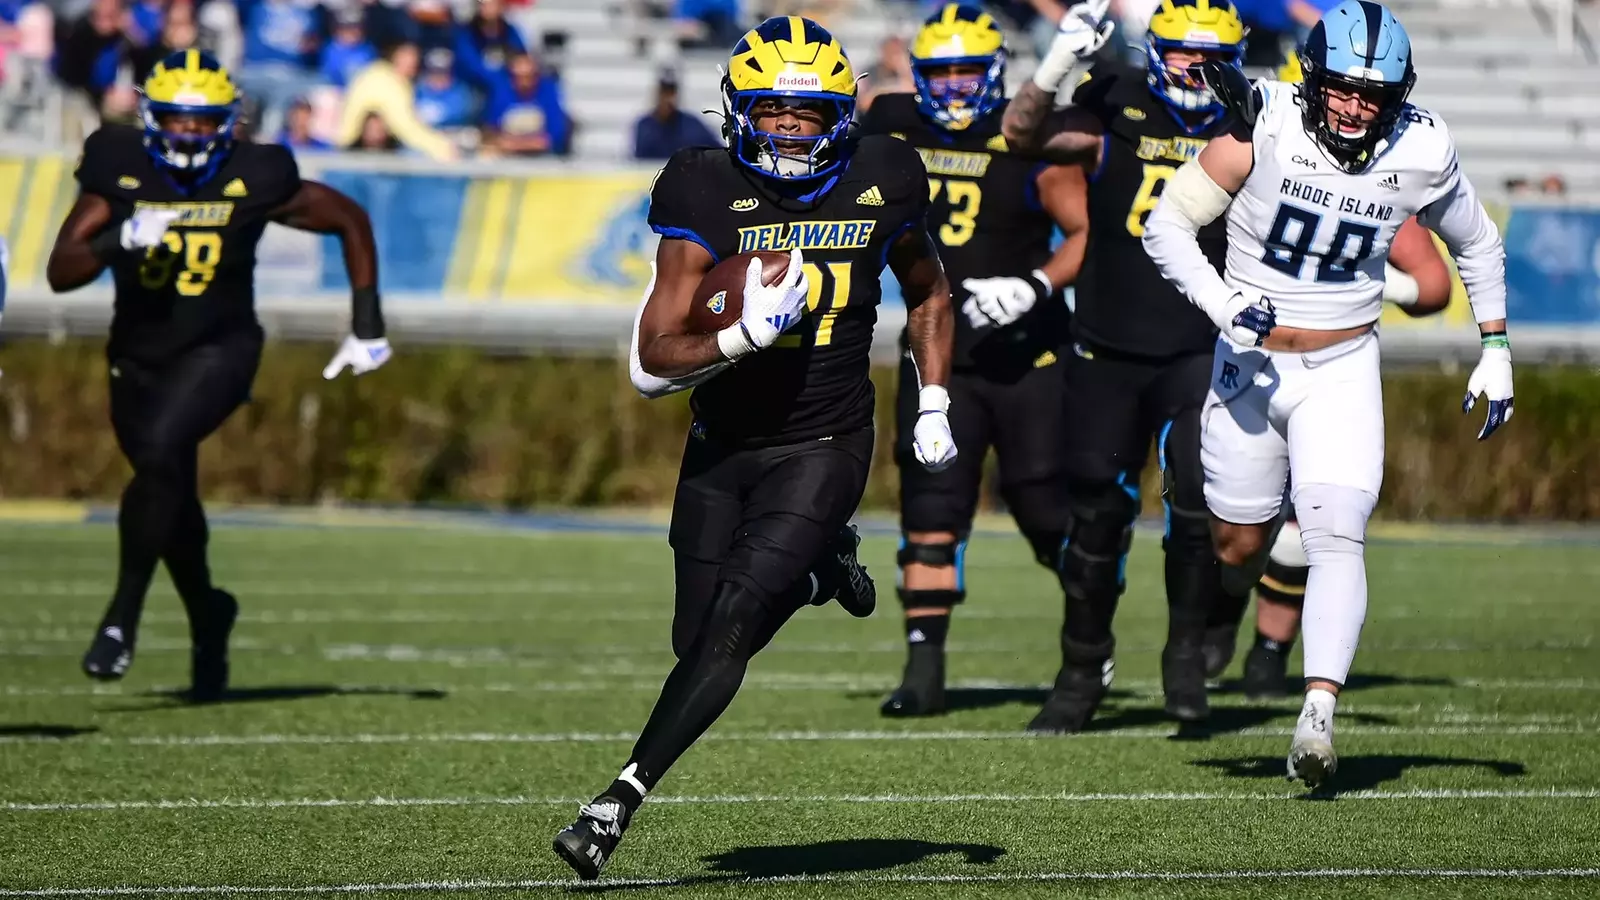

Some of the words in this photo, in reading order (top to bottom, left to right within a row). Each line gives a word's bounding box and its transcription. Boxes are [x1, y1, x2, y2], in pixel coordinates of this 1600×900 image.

[778, 77, 818, 87] Riddell
[1291, 155, 1317, 171] CAA
[732, 197, 754, 209] CAA
[856, 196, 885, 207] adidas
[1280, 178, 1334, 208] RHODE
[1339, 195, 1394, 221] ISLAND
[927, 178, 981, 247] 3
[737, 219, 877, 254] DELAWARE
[1261, 201, 1381, 283] 90
